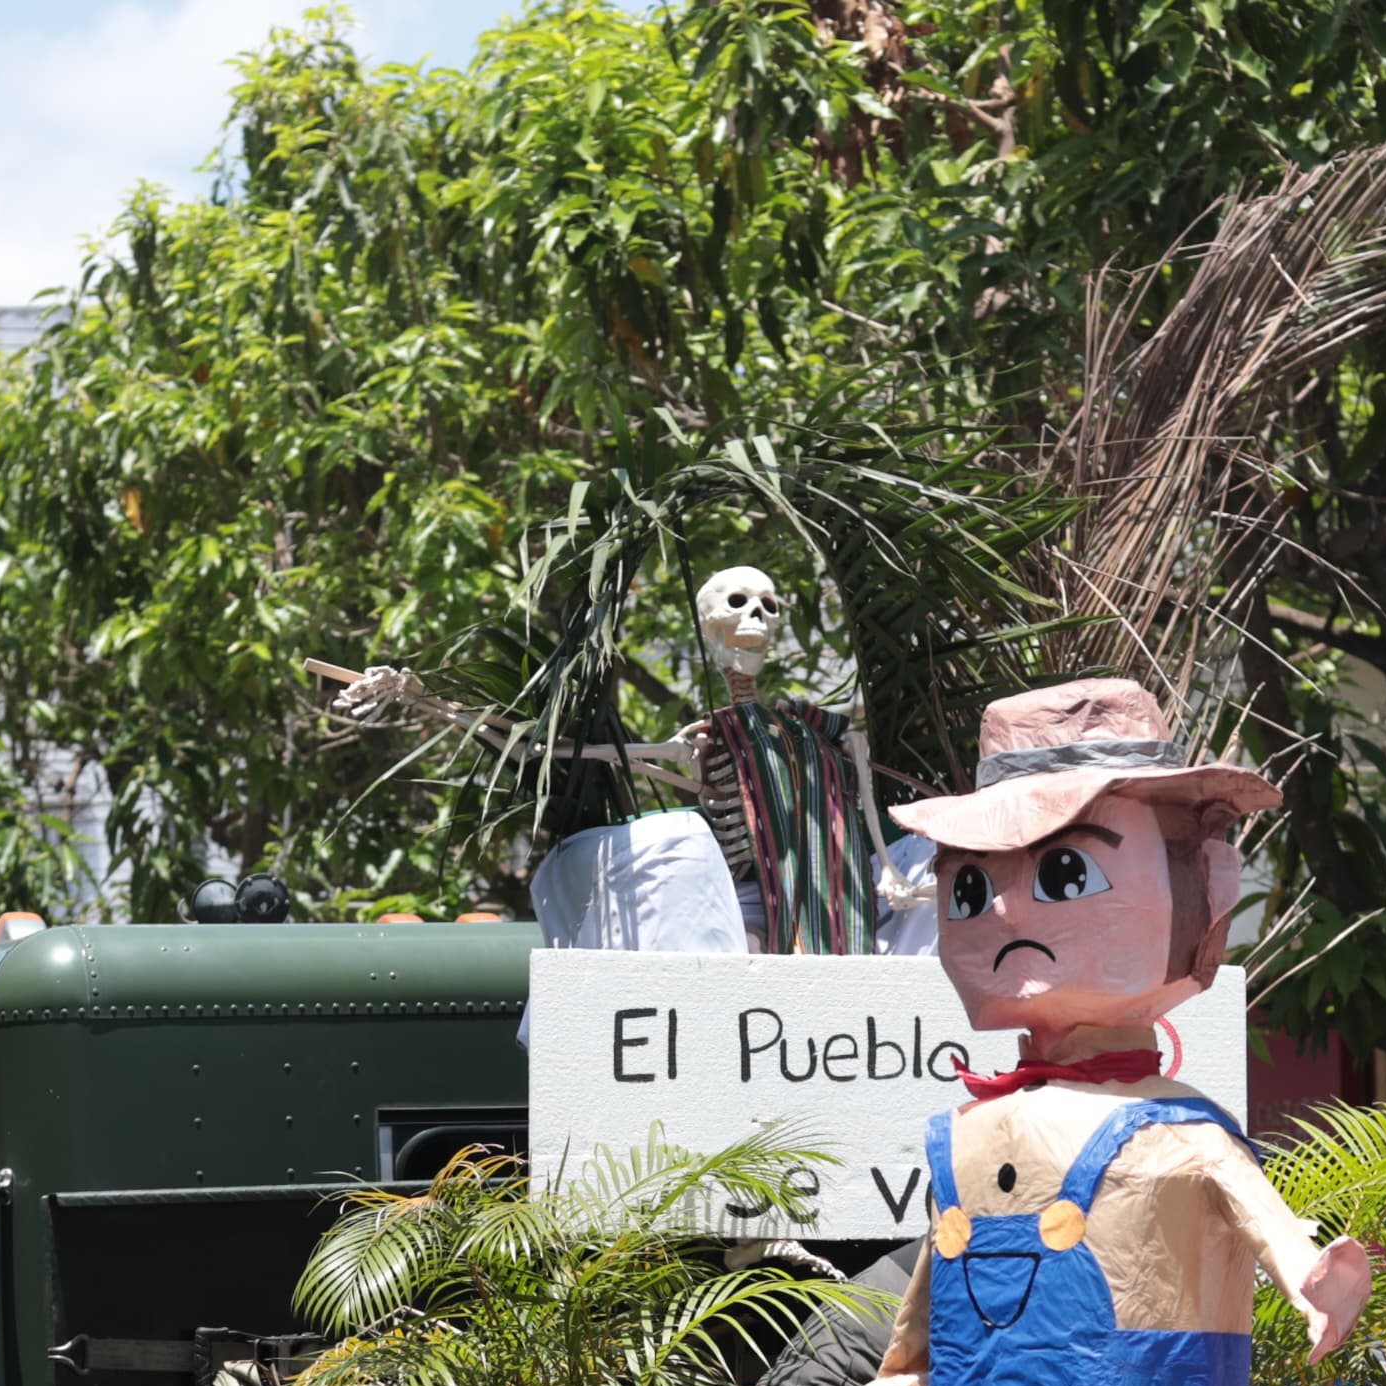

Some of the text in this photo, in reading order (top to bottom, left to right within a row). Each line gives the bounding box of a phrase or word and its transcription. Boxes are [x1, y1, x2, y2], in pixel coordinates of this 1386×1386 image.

[614, 1008, 970, 1083] El Pueblo
[870, 1166, 933, 1224] v
